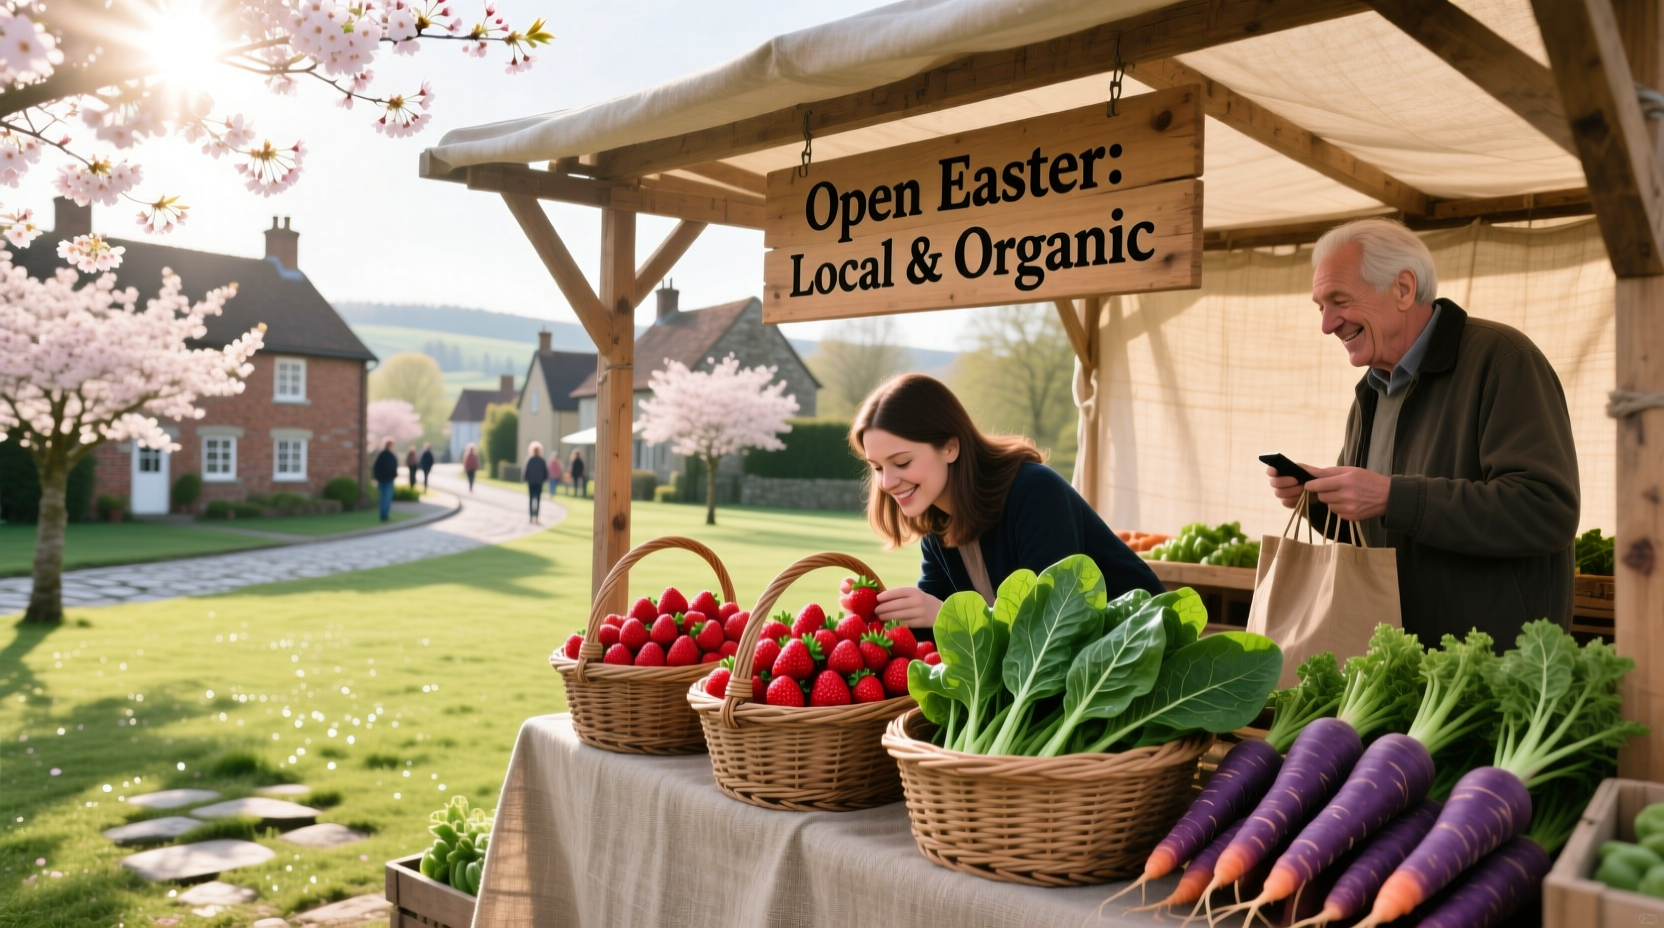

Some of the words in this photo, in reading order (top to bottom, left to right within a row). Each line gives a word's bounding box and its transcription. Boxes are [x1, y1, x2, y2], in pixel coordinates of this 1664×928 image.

[805, 179, 923, 244] Open
[936, 143, 1124, 212] Easter:
[789, 237, 895, 299] Local
[905, 235, 943, 286] &
[954, 207, 1156, 292] Organic
